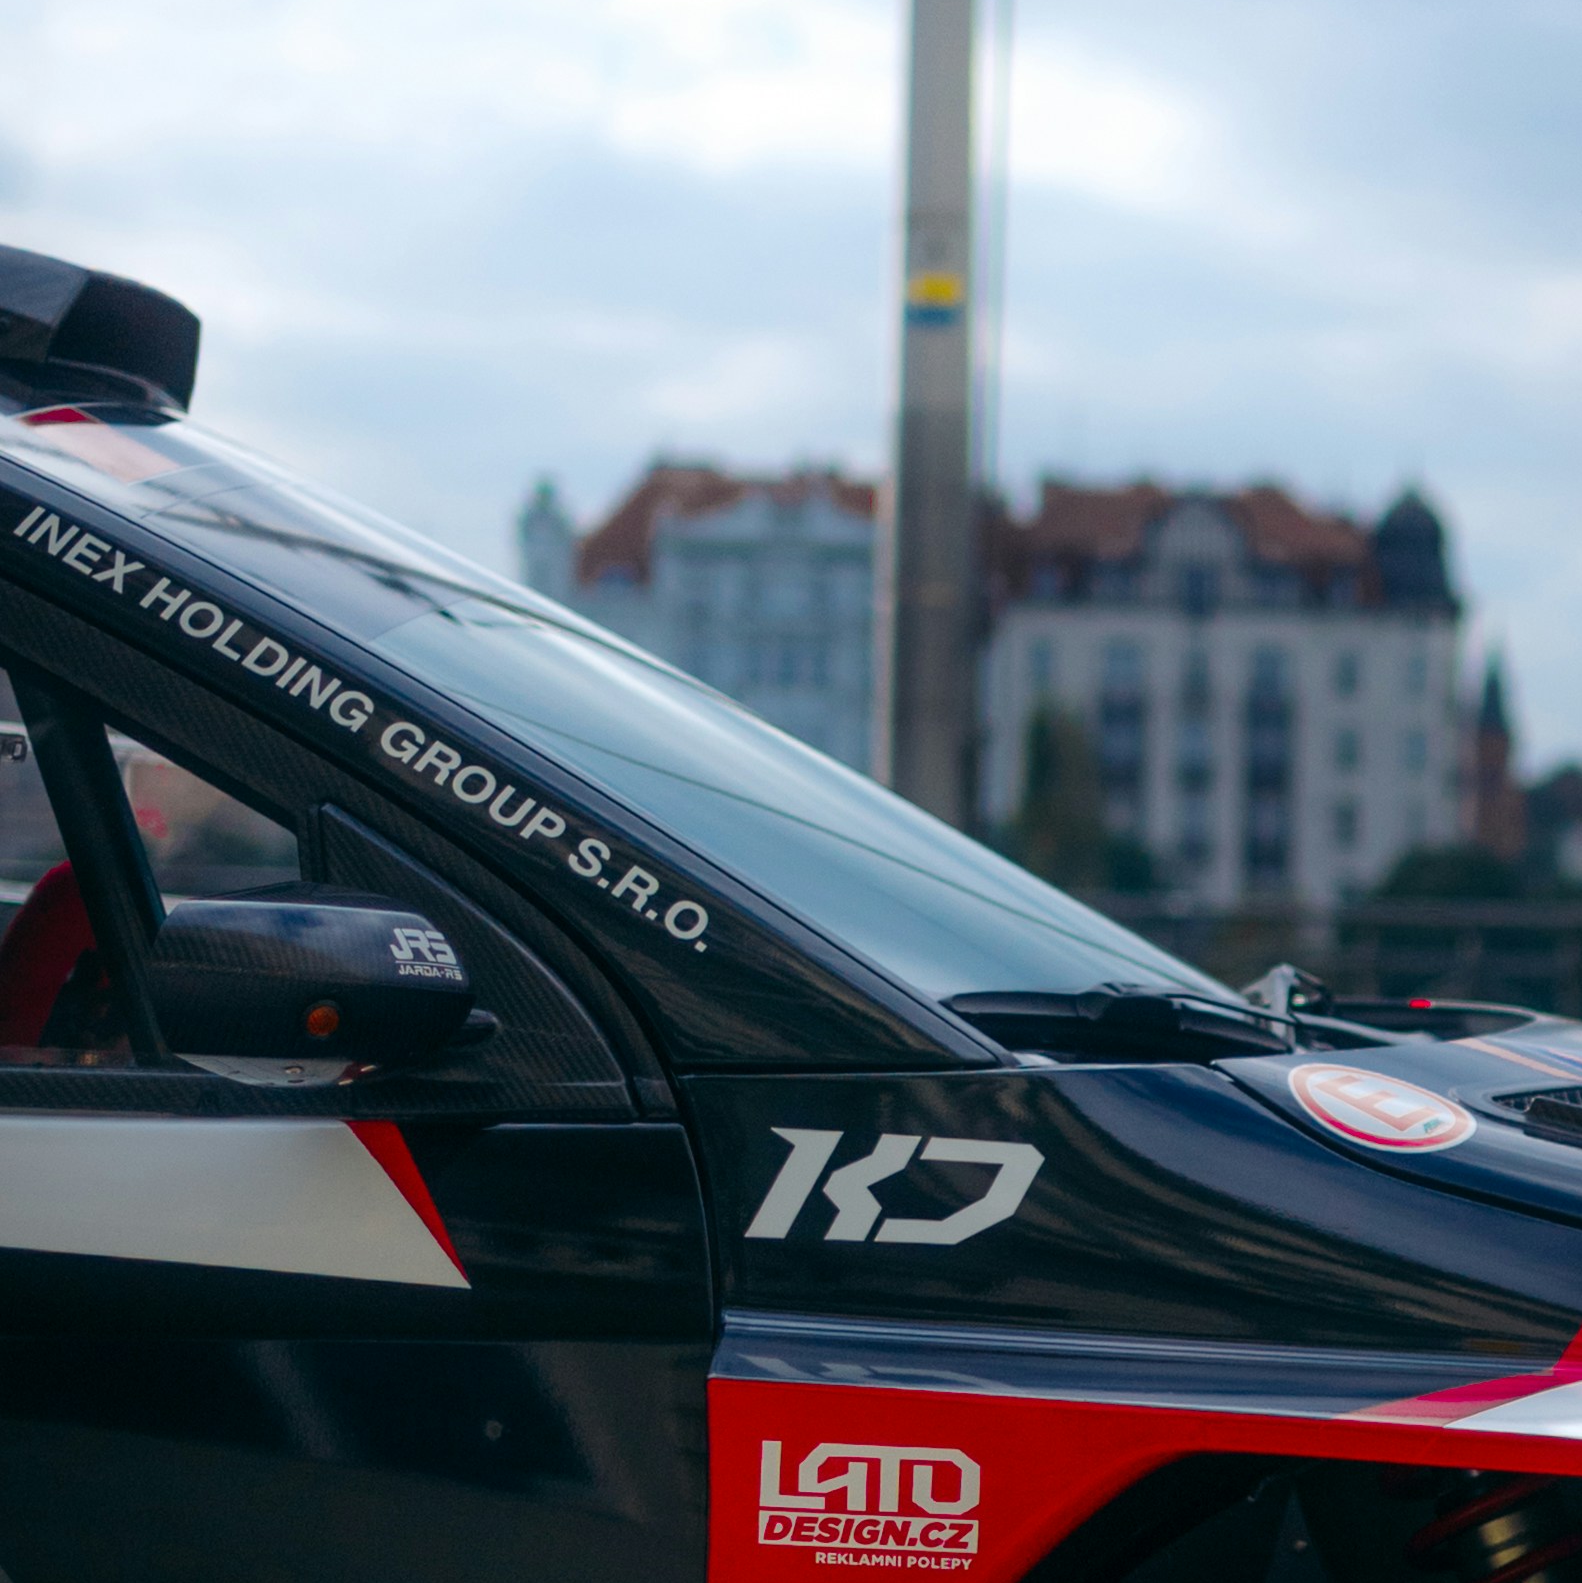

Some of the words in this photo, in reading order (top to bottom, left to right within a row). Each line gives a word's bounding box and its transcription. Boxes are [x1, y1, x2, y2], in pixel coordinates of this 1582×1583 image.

[14, 506, 145, 594] INEX
[138, 575, 376, 733] HOLDING
[380, 721, 567, 844] GROUP
[567, 837, 710, 953] S.R.O.
[389, 927, 456, 965] JRS
[758, 1439, 981, 1516] LATO
[762, 1514, 975, 1550] DESIGN.CZ
[814, 1551, 903, 1568] REKLAMNI
[906, 1554, 974, 1571] POLEPY
